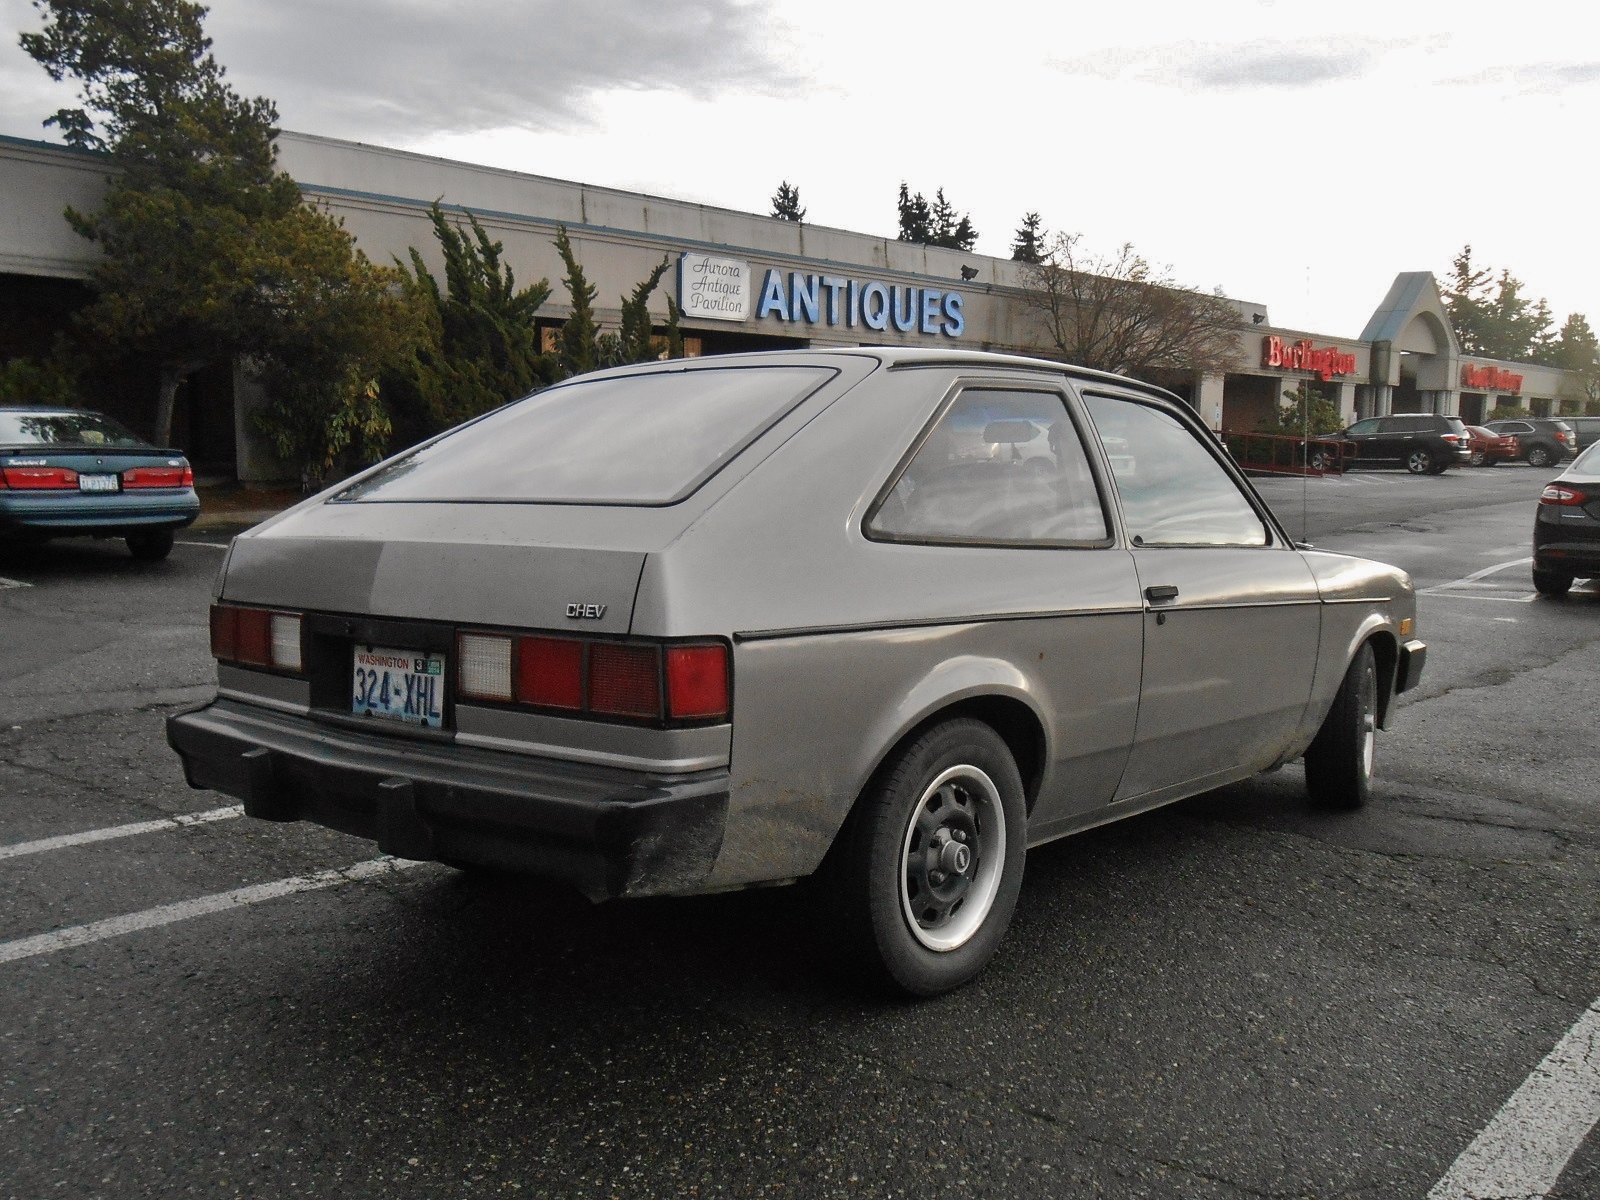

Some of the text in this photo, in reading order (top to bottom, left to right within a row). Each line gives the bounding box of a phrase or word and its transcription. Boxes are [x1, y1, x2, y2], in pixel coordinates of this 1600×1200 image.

[693, 257, 741, 278] Aurora
[692, 275, 742, 297] Antique
[690, 292, 742, 313] Pavilion
[757, 269, 966, 338] ANTIQUES
[1266, 335, 1356, 382] Burlington
[565, 603, 607, 619] CHEV
[358, 653, 409, 670] WASHINGTON
[415, 660, 424, 671] 3
